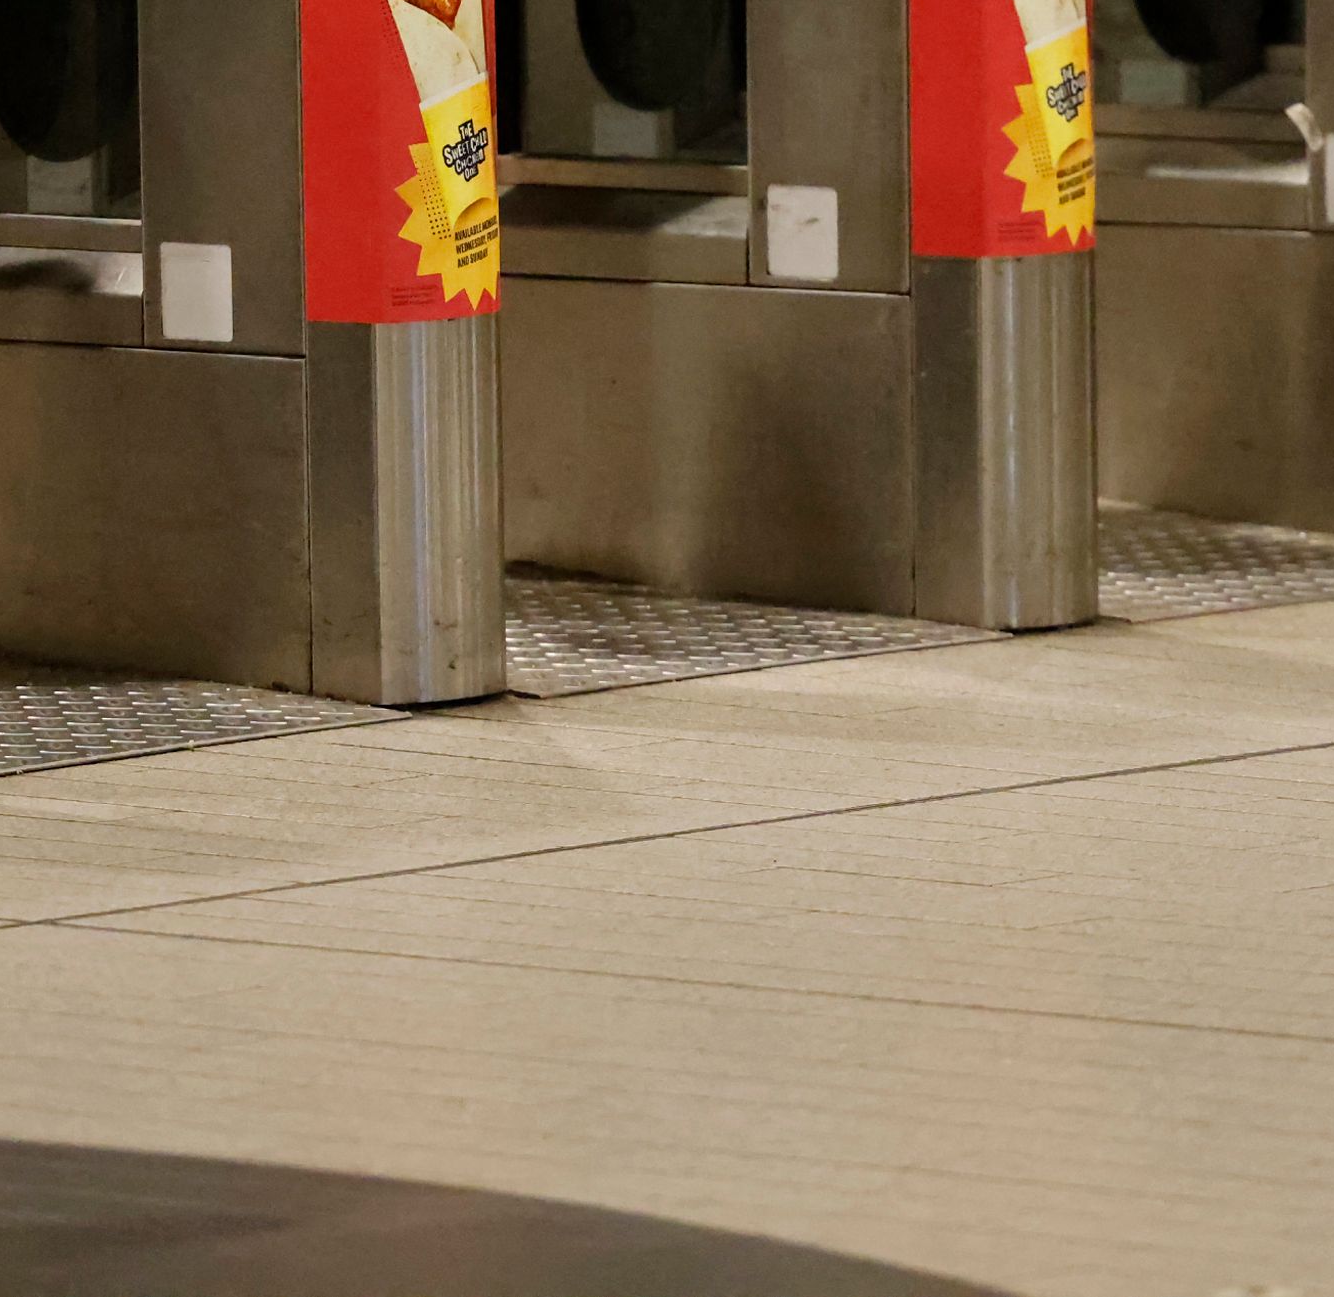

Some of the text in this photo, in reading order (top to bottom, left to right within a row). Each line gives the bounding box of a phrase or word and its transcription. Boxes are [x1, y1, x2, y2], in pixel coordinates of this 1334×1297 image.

[459, 122, 474, 141] THE
[443, 140, 471, 166] SWEET
[454, 223, 482, 242] AVAILABLE
[457, 255, 470, 269] AND
